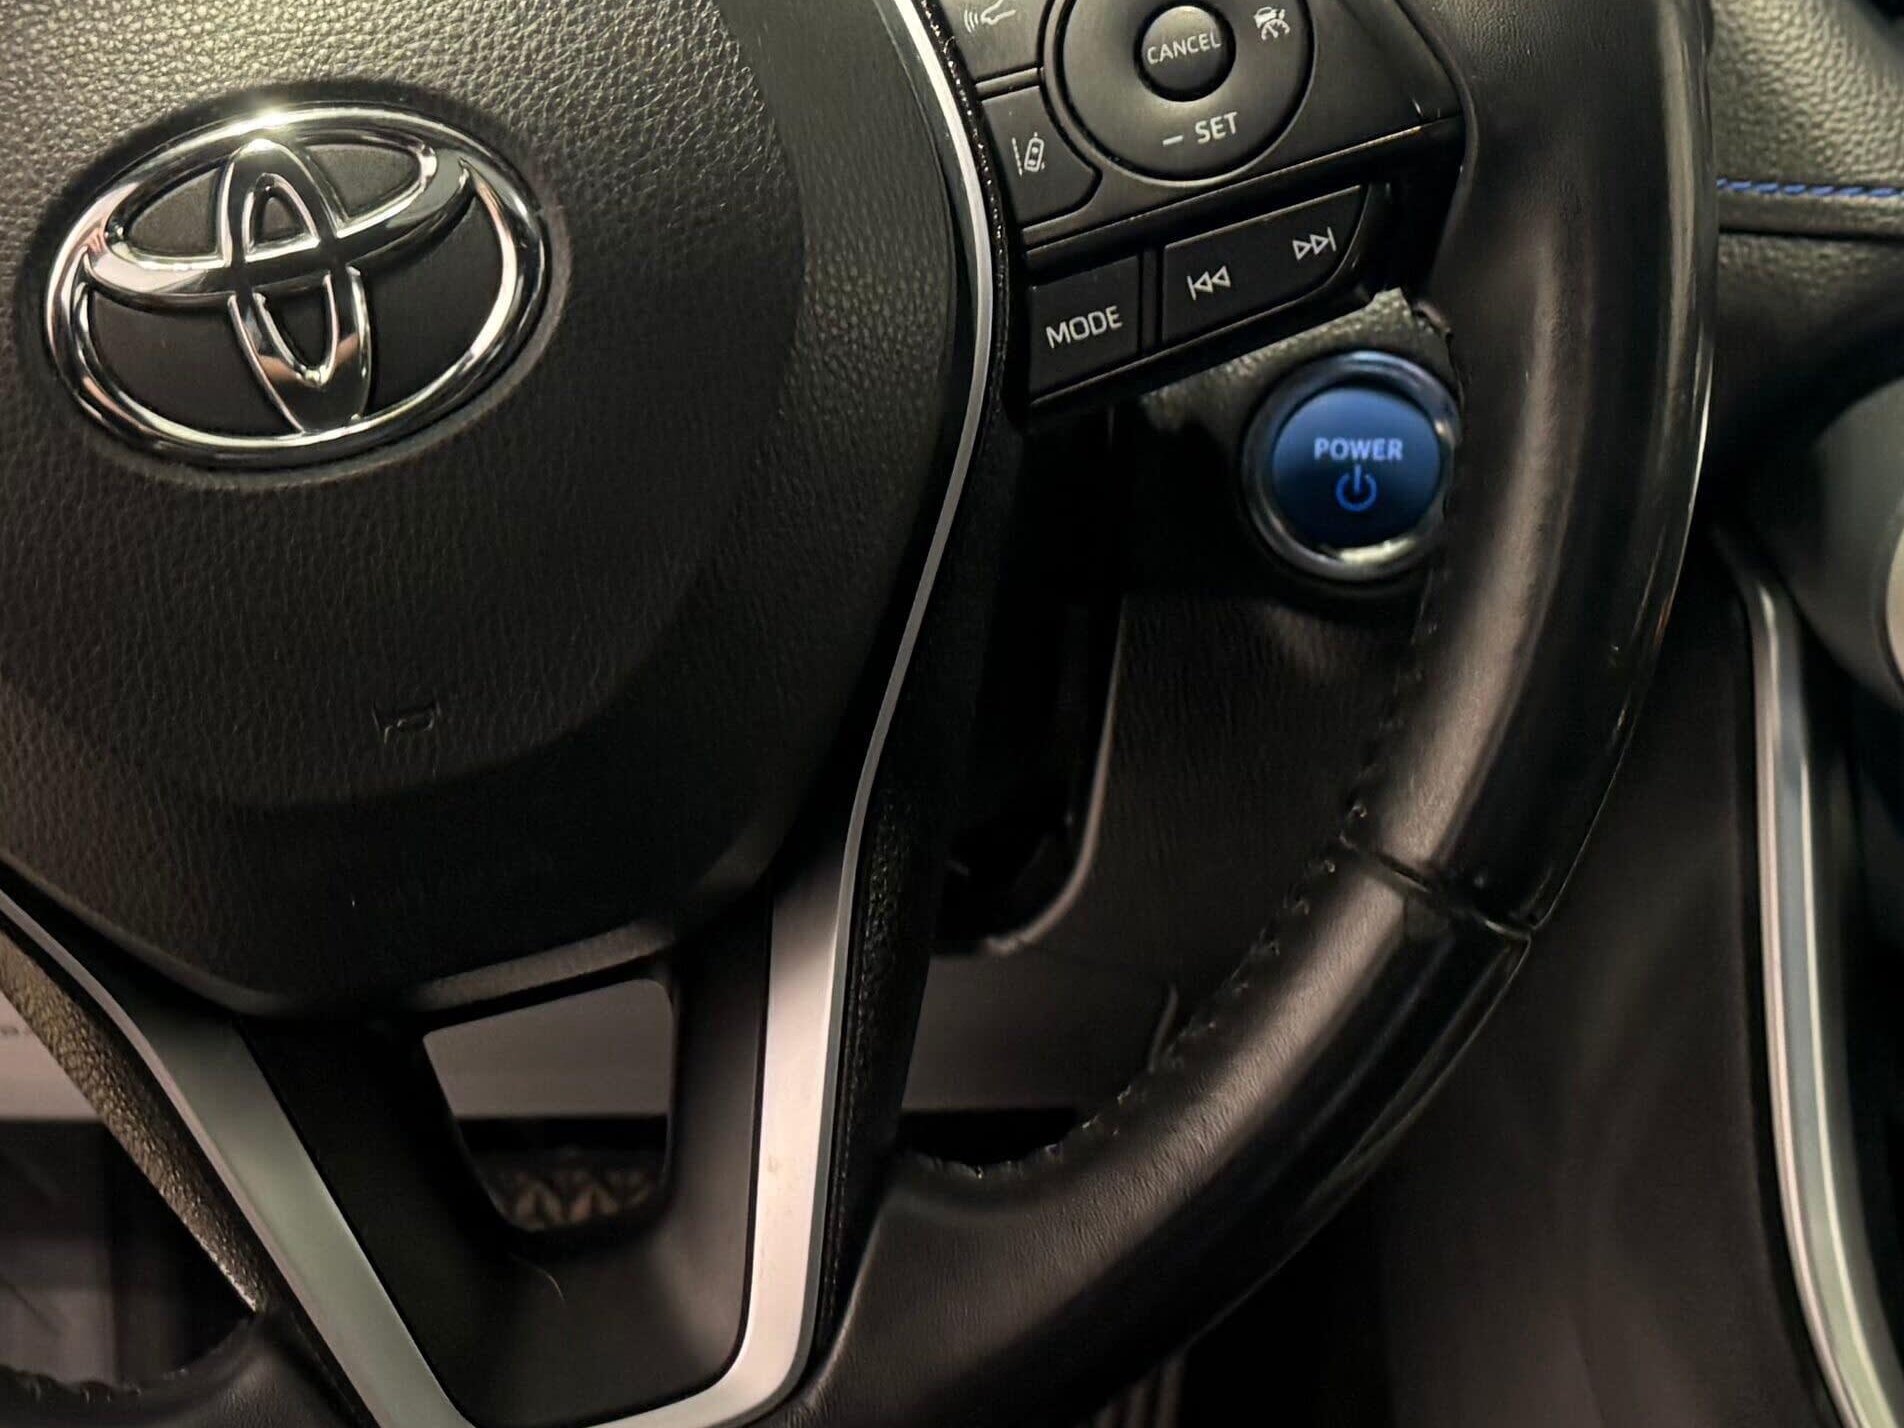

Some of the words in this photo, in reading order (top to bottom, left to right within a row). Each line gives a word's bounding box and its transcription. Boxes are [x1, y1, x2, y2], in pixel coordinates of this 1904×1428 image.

[1147, 29, 1222, 64] CANCEL
[1194, 111, 1241, 144] SET
[1046, 304, 1123, 348] MODE
[1314, 436, 1404, 463] POWER
